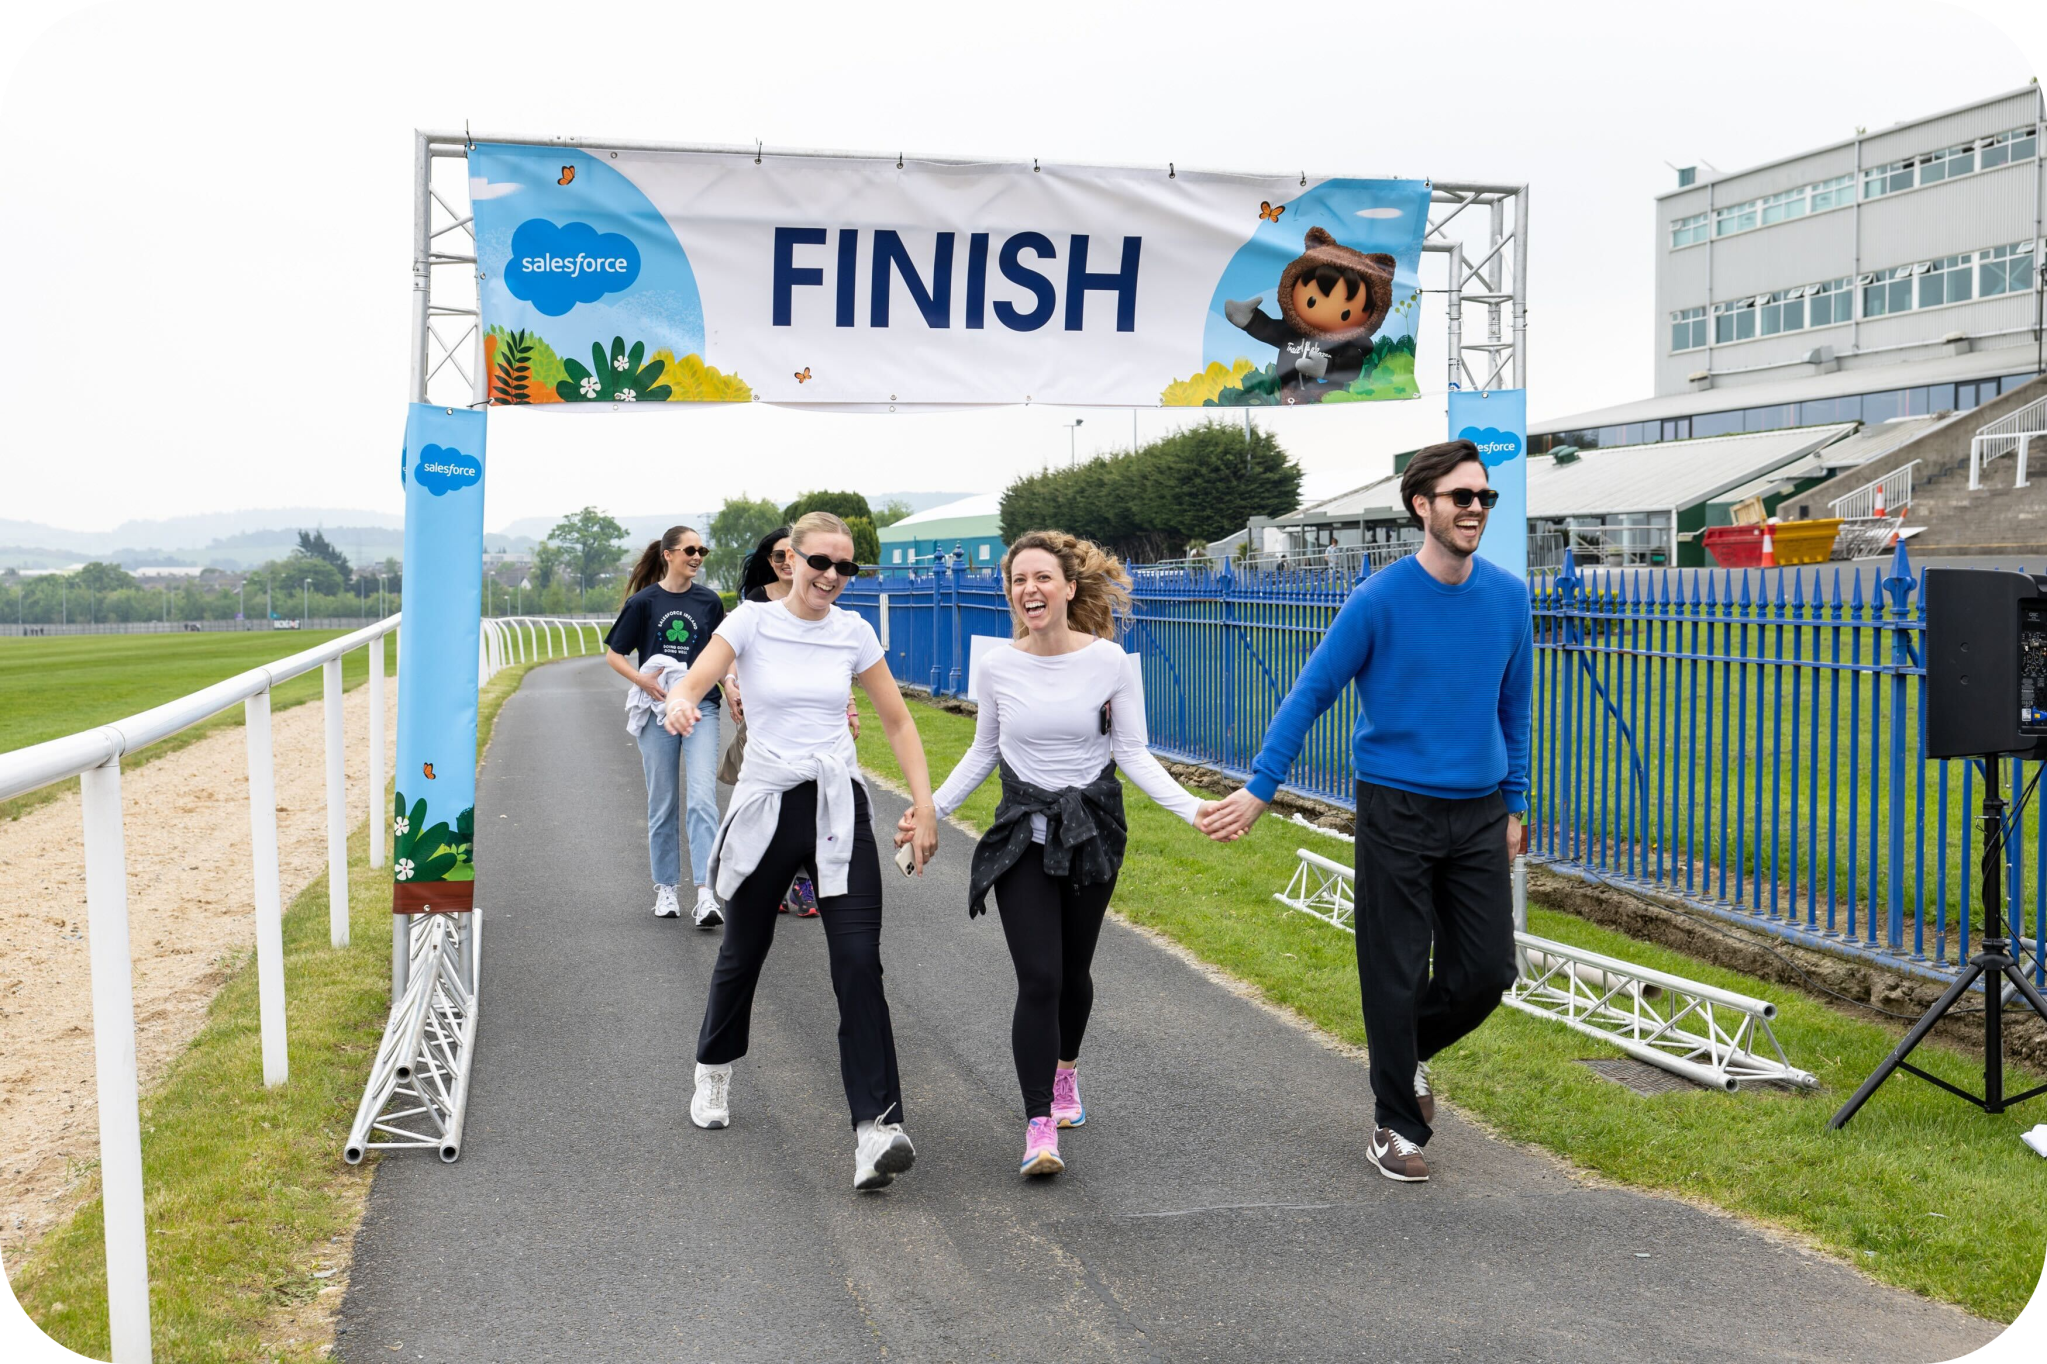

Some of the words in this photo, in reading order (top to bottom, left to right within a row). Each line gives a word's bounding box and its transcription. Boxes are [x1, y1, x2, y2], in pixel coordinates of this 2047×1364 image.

[522, 252, 628, 278] salesforce
[772, 227, 1143, 332] FINISH
[1474, 441, 1516, 455] lesforce
[424, 461, 476, 477] salesforce
[658, 610, 683, 628] SALESFORCE
[683, 612, 698, 630] IRELAND
